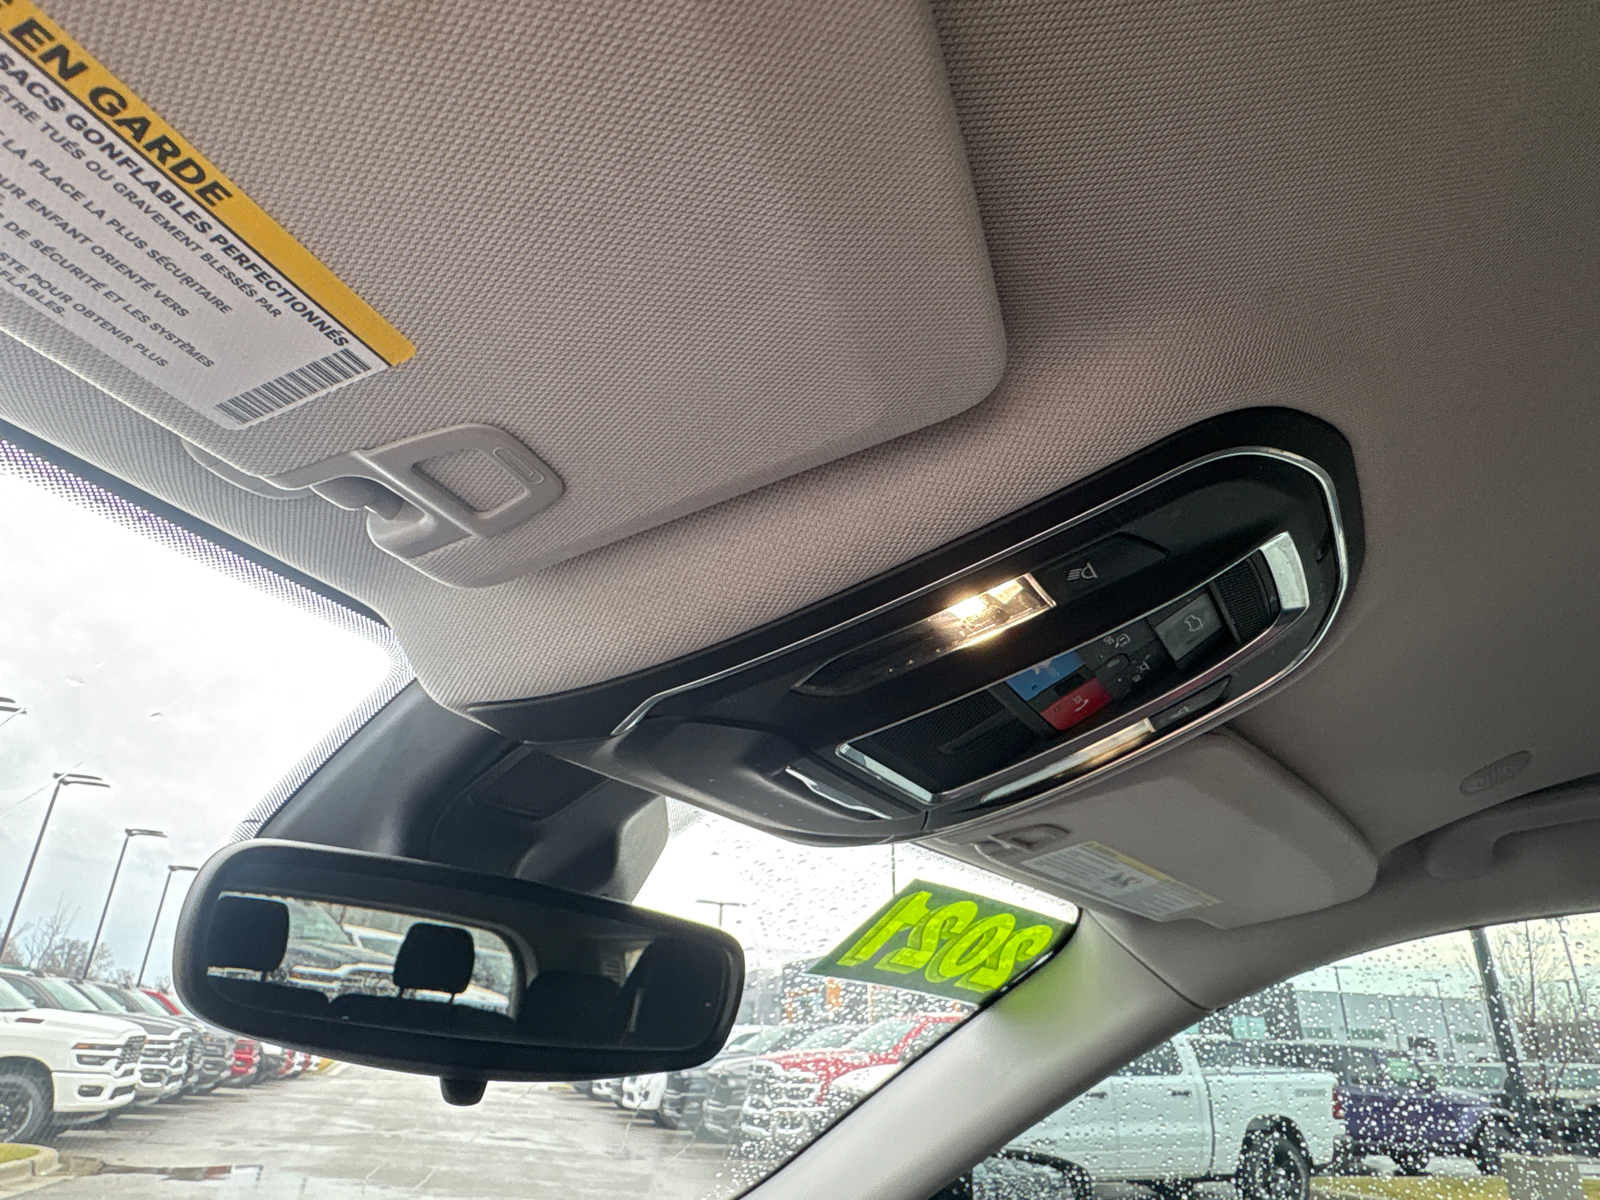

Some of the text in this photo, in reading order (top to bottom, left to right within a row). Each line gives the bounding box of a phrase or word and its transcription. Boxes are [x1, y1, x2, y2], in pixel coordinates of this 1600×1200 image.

[0, 53, 349, 347] SACS GONFLABLES PERFECTIONNÉS
[10, 18, 232, 207] EN GARDE
[0, 173, 189, 317] UR ENFANT ORIENTÉ VERS
[2, 139, 27, 160] LA
[28, 158, 86, 202] PLACE
[83, 200, 105, 219] LA
[106, 218, 148, 249] PLUS
[146, 249, 233, 315] SÉCURITAIRE
[4, 221, 215, 368] DE SÉCURITÉ ET LES SYSTÈMES
[40, 121, 86, 160] TUÉS
[85, 160, 114, 181] OU
[112, 181, 203, 252] GRAVEMENT
[200, 253, 257, 298] BLESSÉS
[255, 297, 282, 318] PAR
[27, 273, 73, 304] POUR
[72, 303, 134, 344] OBTENIR
[132, 342, 169, 367] PLUS
